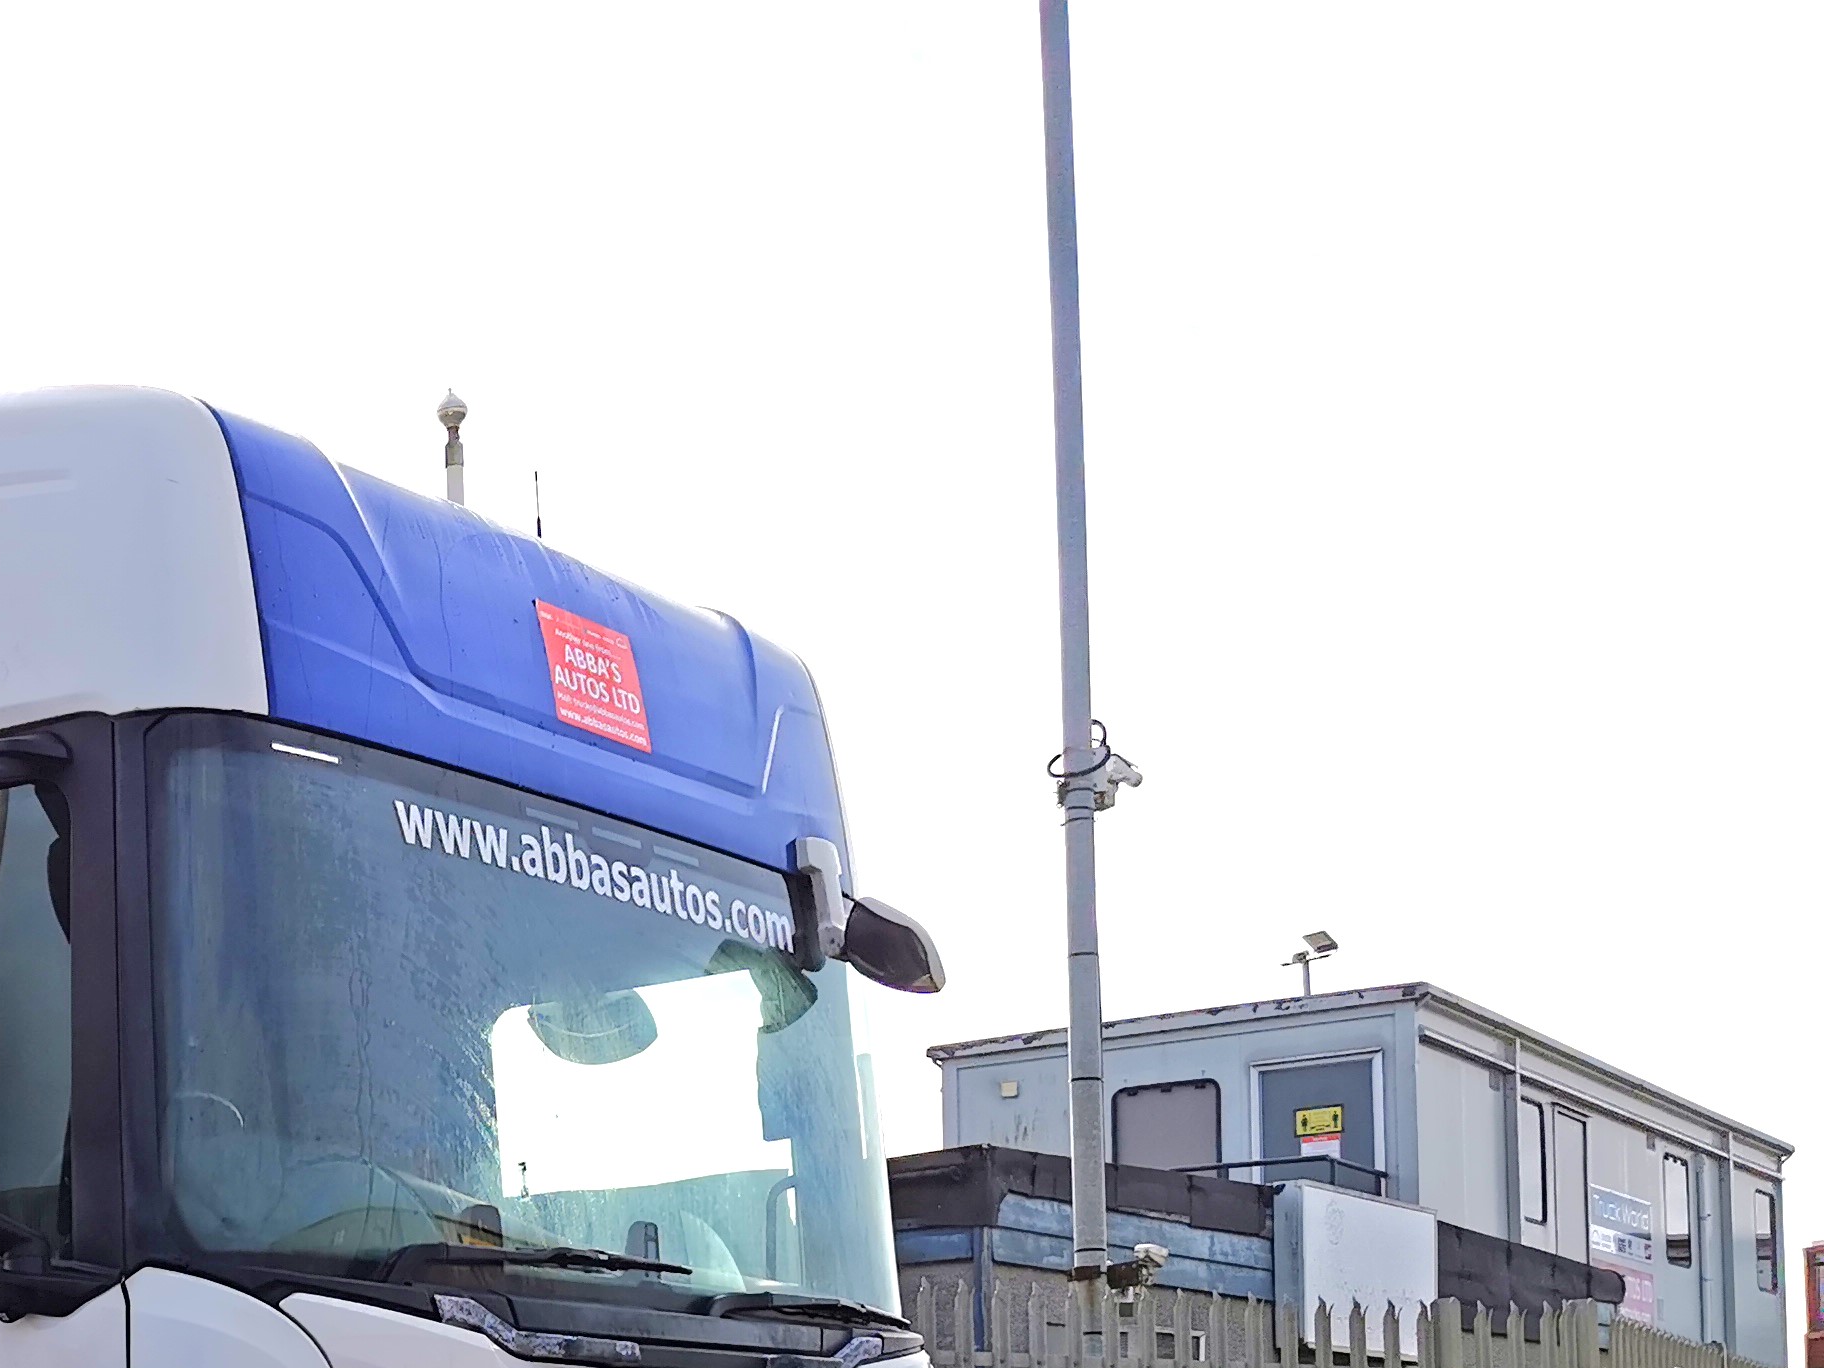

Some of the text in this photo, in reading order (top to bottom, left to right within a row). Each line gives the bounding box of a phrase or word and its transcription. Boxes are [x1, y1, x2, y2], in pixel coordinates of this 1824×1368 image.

[564, 643, 622, 684] ABBA'S
[554, 664, 641, 715] AUTOS LTD
[393, 799, 794, 953] www.abbasautos.com
